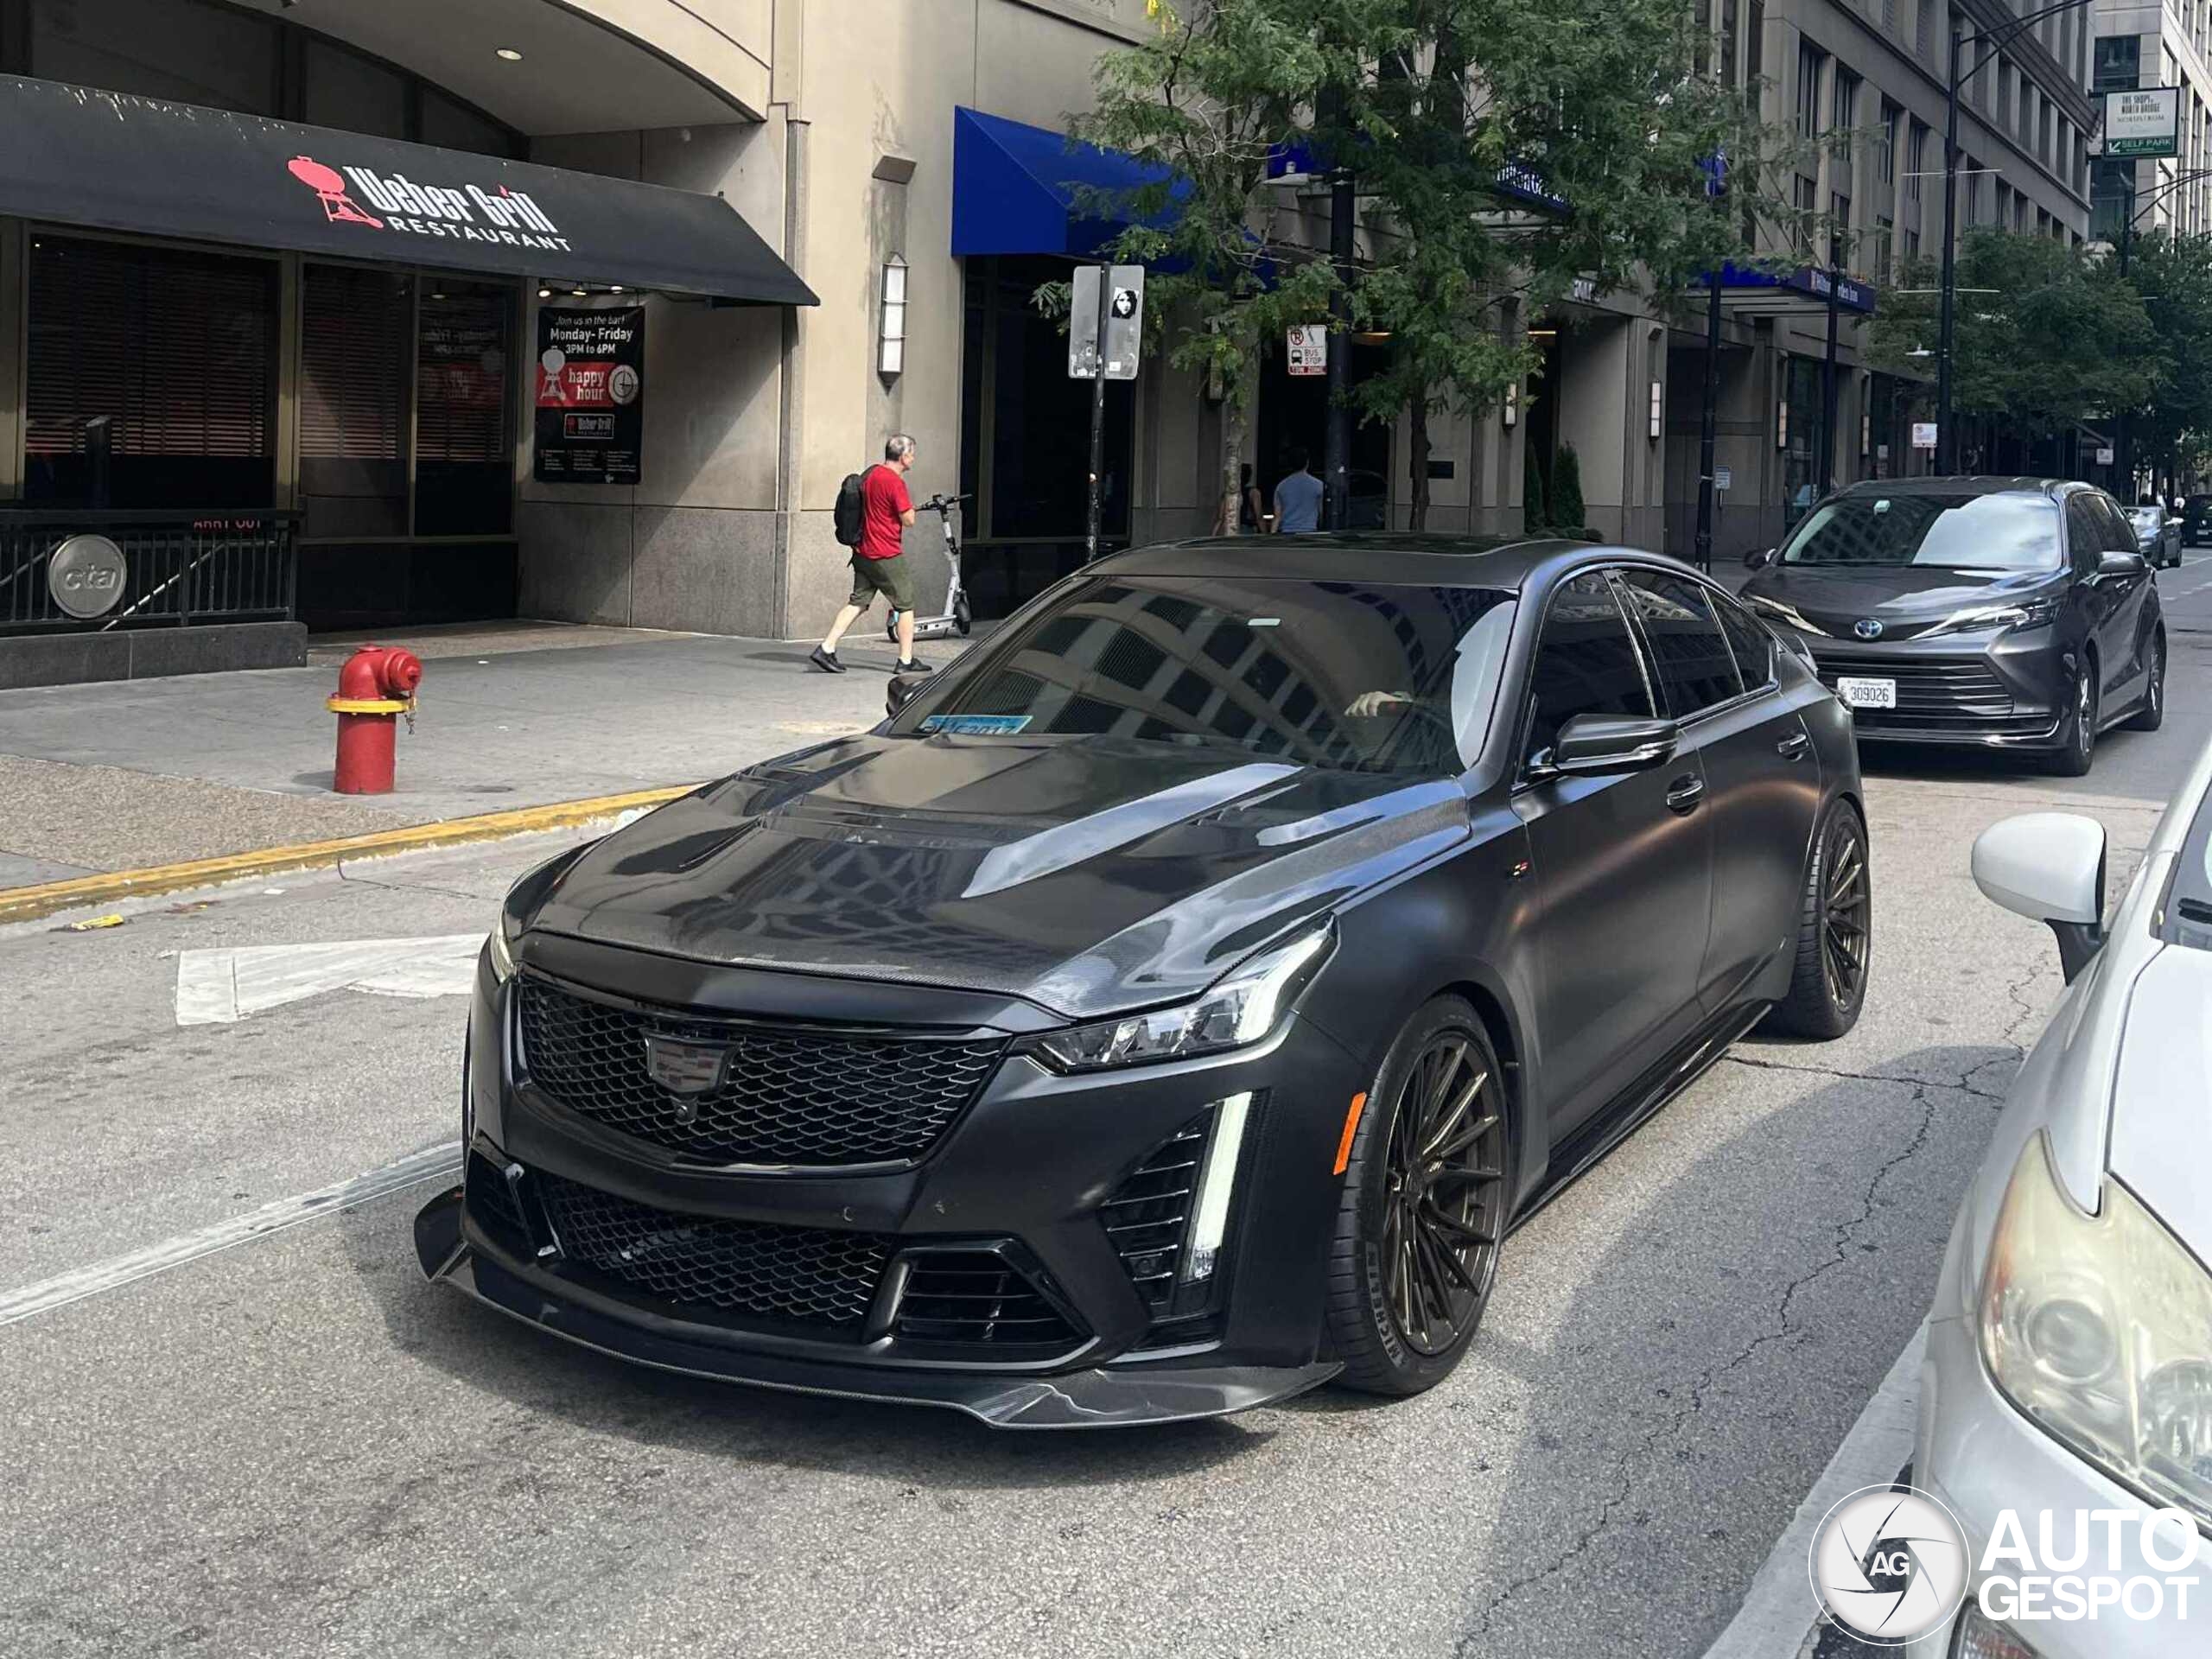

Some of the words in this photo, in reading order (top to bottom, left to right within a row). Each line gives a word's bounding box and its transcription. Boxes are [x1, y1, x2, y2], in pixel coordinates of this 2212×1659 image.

[342, 165, 474, 222] Weber
[465, 182, 558, 233] Grill
[386, 215, 572, 251] RESTAURANT
[594, 315, 607, 325] the
[550, 327, 596, 343] Monday-
[598, 327, 633, 342] Friday
[566, 344, 584, 354] 3PM
[586, 344, 594, 354] to
[596, 343, 616, 354] 6PM
[569, 367, 605, 387] happy
[576, 385, 605, 401] hour
[64, 563, 116, 591] cta
[1851, 686, 1889, 702] 309026
